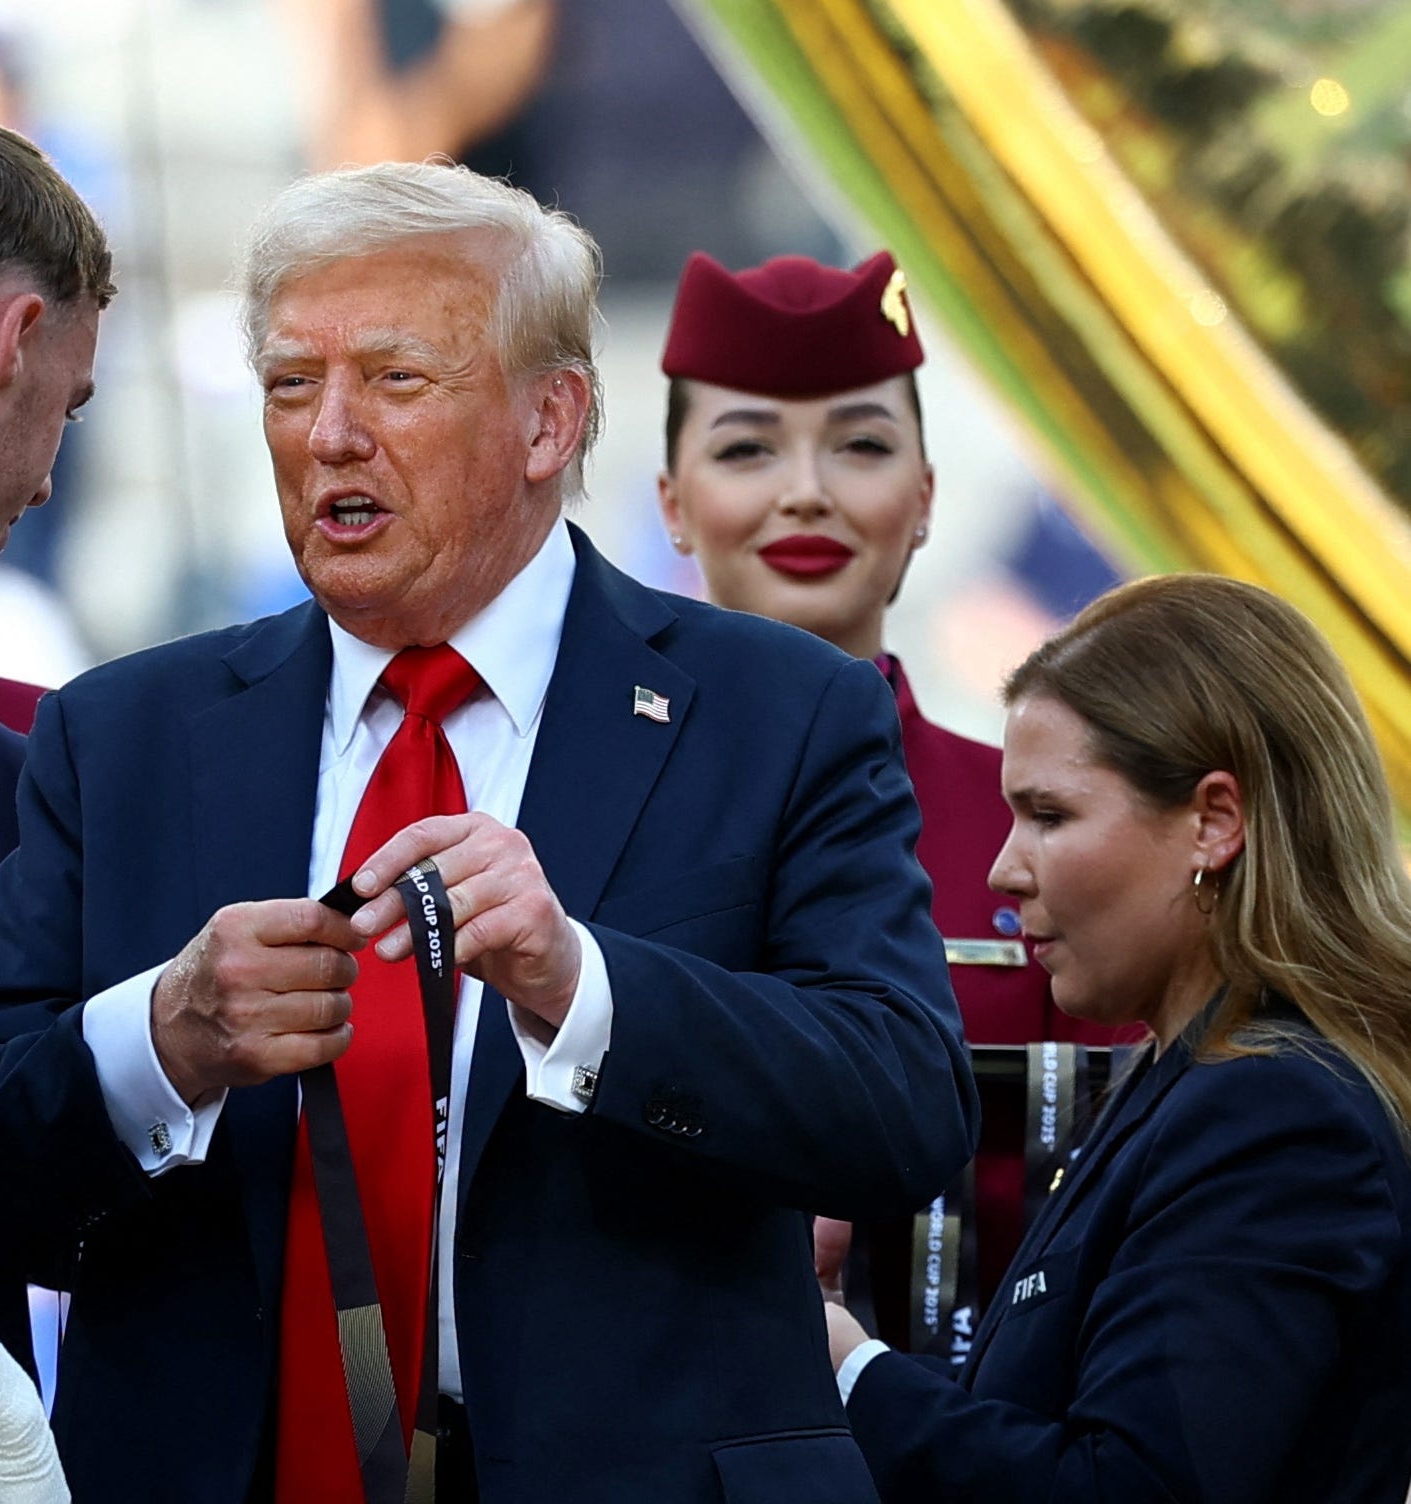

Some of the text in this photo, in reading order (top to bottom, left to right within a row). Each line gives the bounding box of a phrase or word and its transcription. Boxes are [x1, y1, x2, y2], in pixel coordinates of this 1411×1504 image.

[422, 894, 438, 926] CUP
[1042, 1071, 1058, 1103] CUP
[926, 1253, 941, 1285] CUP
[1012, 1271, 1047, 1304] FIFA
